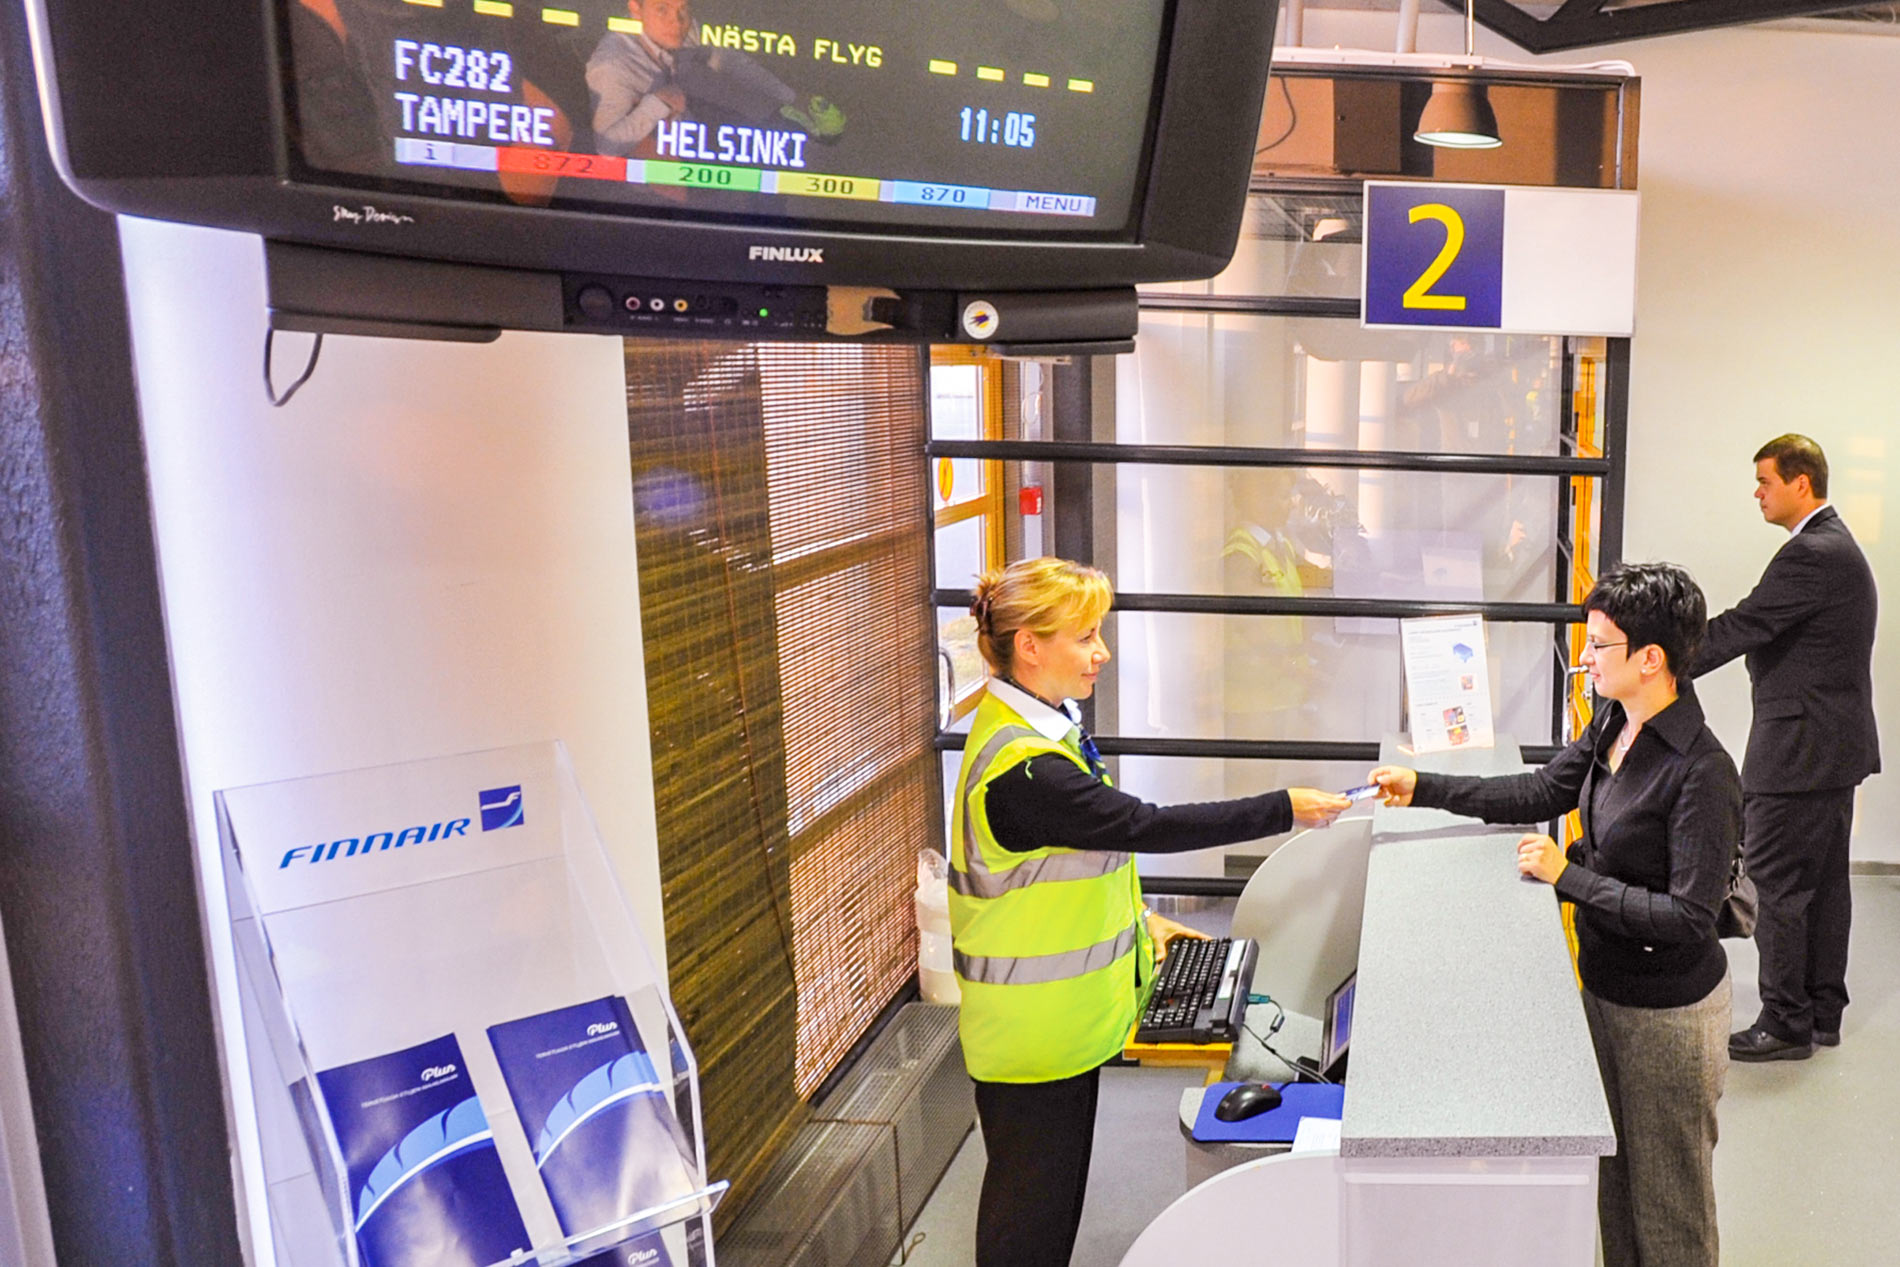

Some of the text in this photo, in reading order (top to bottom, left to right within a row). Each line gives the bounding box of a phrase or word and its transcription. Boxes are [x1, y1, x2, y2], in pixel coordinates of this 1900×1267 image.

[394, 39, 513, 93] FC282
[701, 24, 883, 68] NÄSTA FLYG
[394, 92, 555, 145] TAMPERE
[656, 119, 807, 168] HELSINKI
[959, 106, 1037, 148] 11:05
[532, 155, 594, 174] 872
[679, 165, 732, 185] 200
[805, 176, 855, 195] 300
[921, 187, 966, 204] 870
[1025, 195, 1082, 212] MENU
[748, 245, 824, 263] FINLUX
[1401, 202, 1467, 311] 2
[279, 817, 471, 869] FINNAIR
